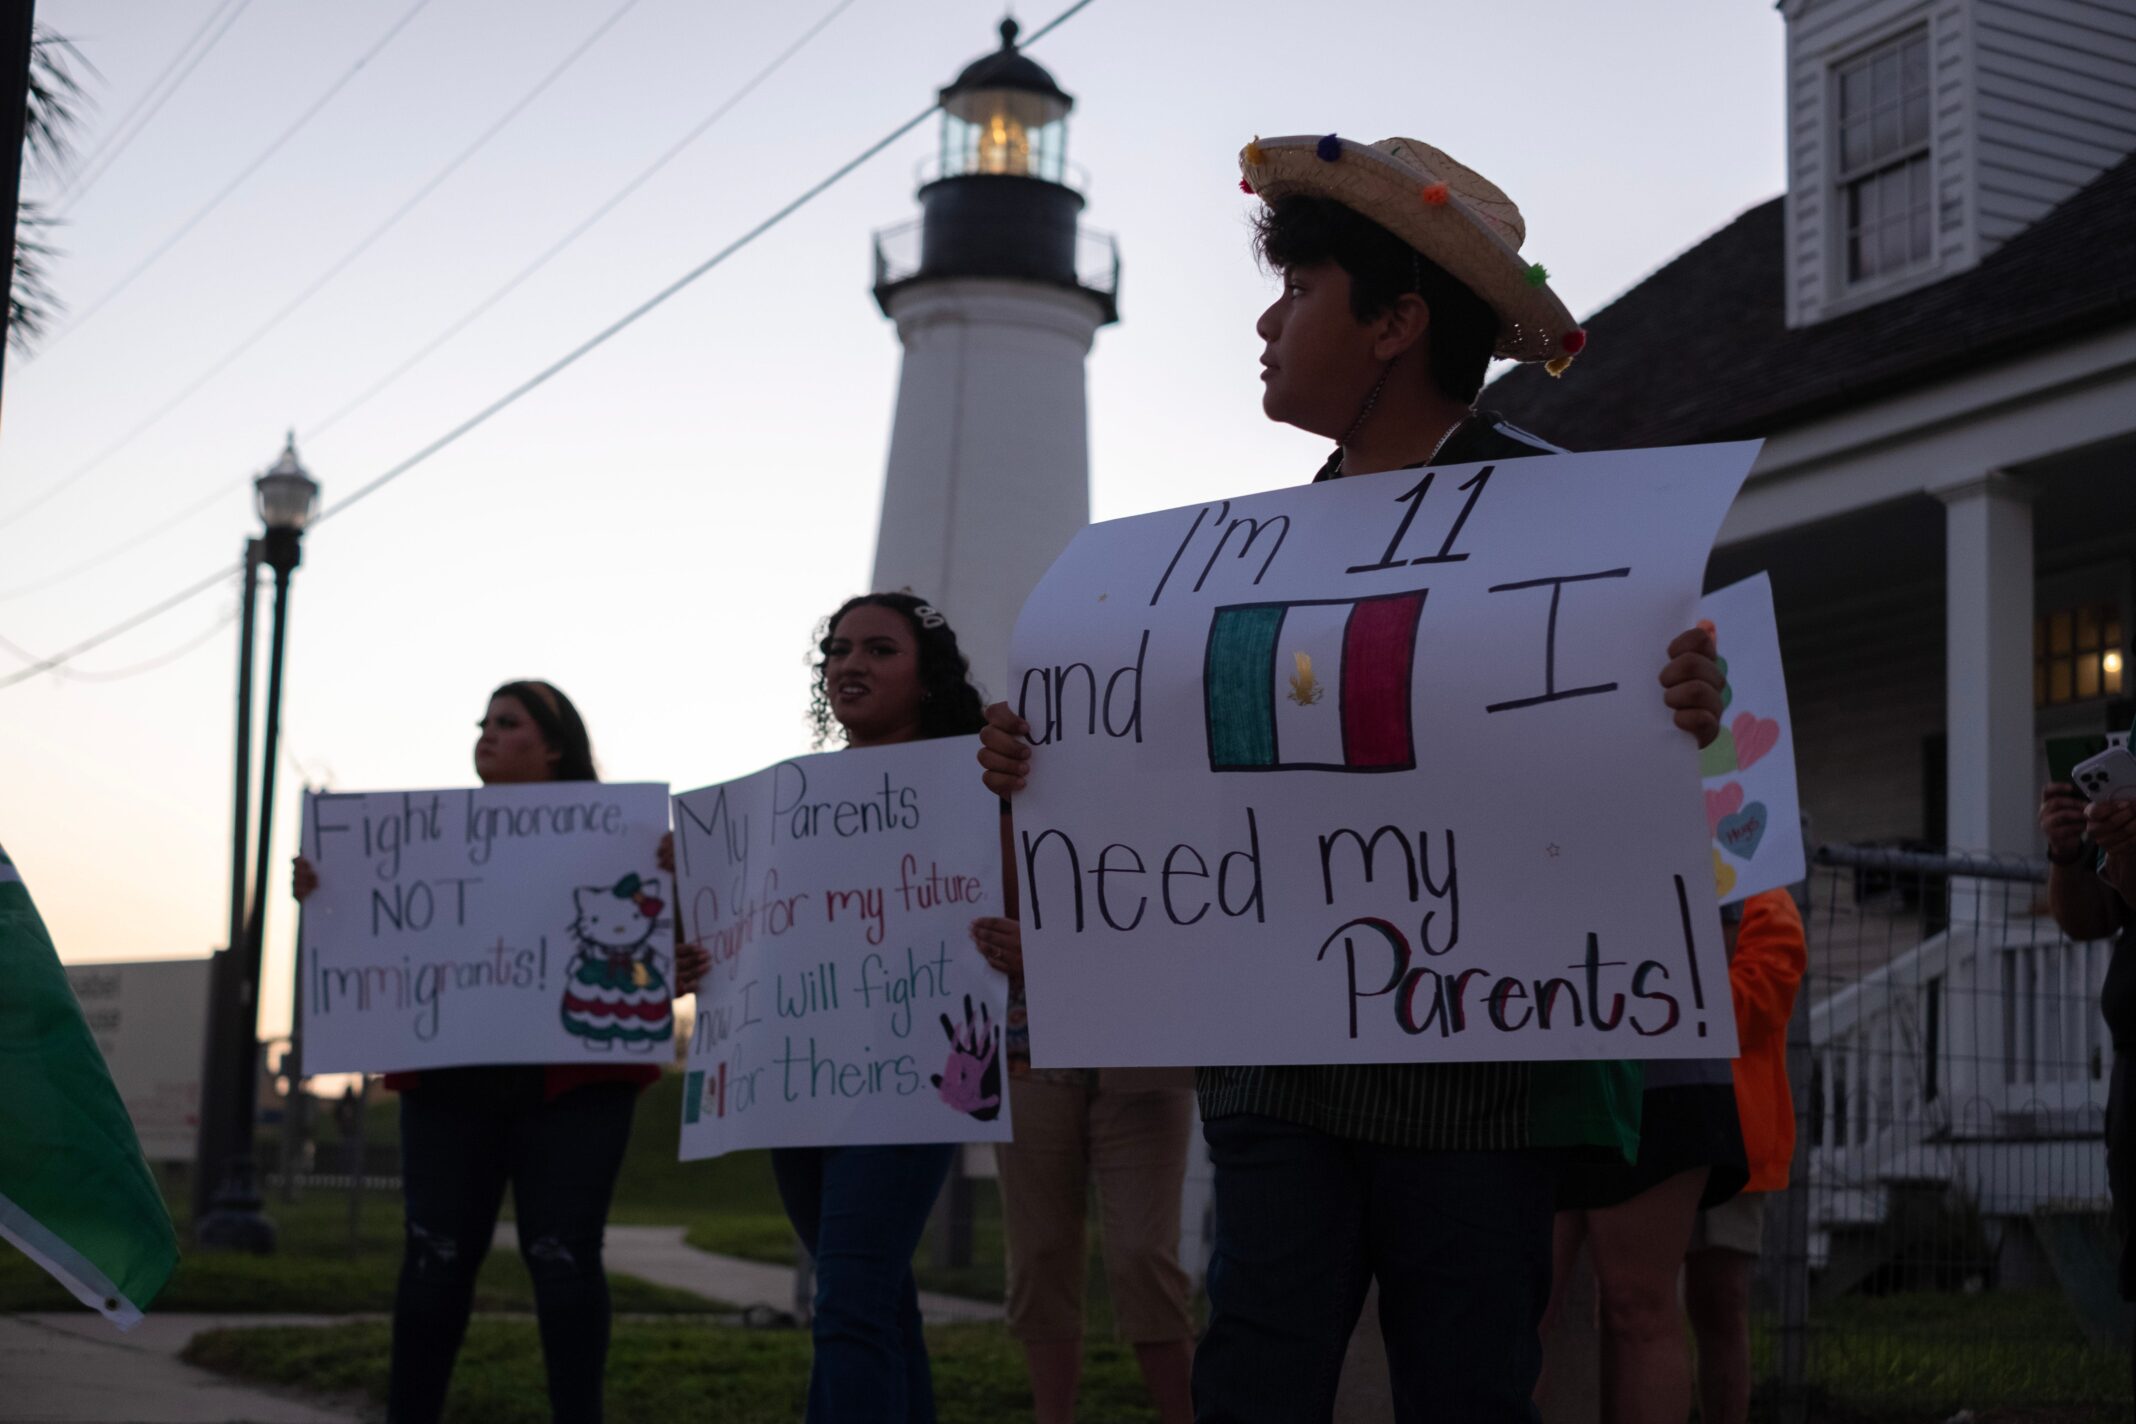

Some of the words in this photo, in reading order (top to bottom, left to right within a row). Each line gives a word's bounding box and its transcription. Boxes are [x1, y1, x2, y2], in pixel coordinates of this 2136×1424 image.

[1149, 501, 1290, 606] I'm
[1345, 465, 1496, 574] 11
[1017, 629, 1150, 745] and
[1486, 567, 1631, 713] I
[312, 794, 442, 881] Fight
[678, 786, 750, 915] My
[770, 760, 920, 848] Parents
[1022, 806, 1266, 932] need
[1318, 824, 1460, 956] my
[1726, 816, 1761, 845] Hugs
[372, 877, 485, 937] NOT
[752, 867, 809, 937] for
[824, 886, 885, 945] my
[1317, 874, 1708, 1039] Parents!
[312, 935, 548, 1042] Immigrants!
[735, 979, 763, 1033] I
[854, 940, 953, 1038] fight
[723, 1043, 766, 1113] for
[772, 1035, 927, 1103] theirs.
